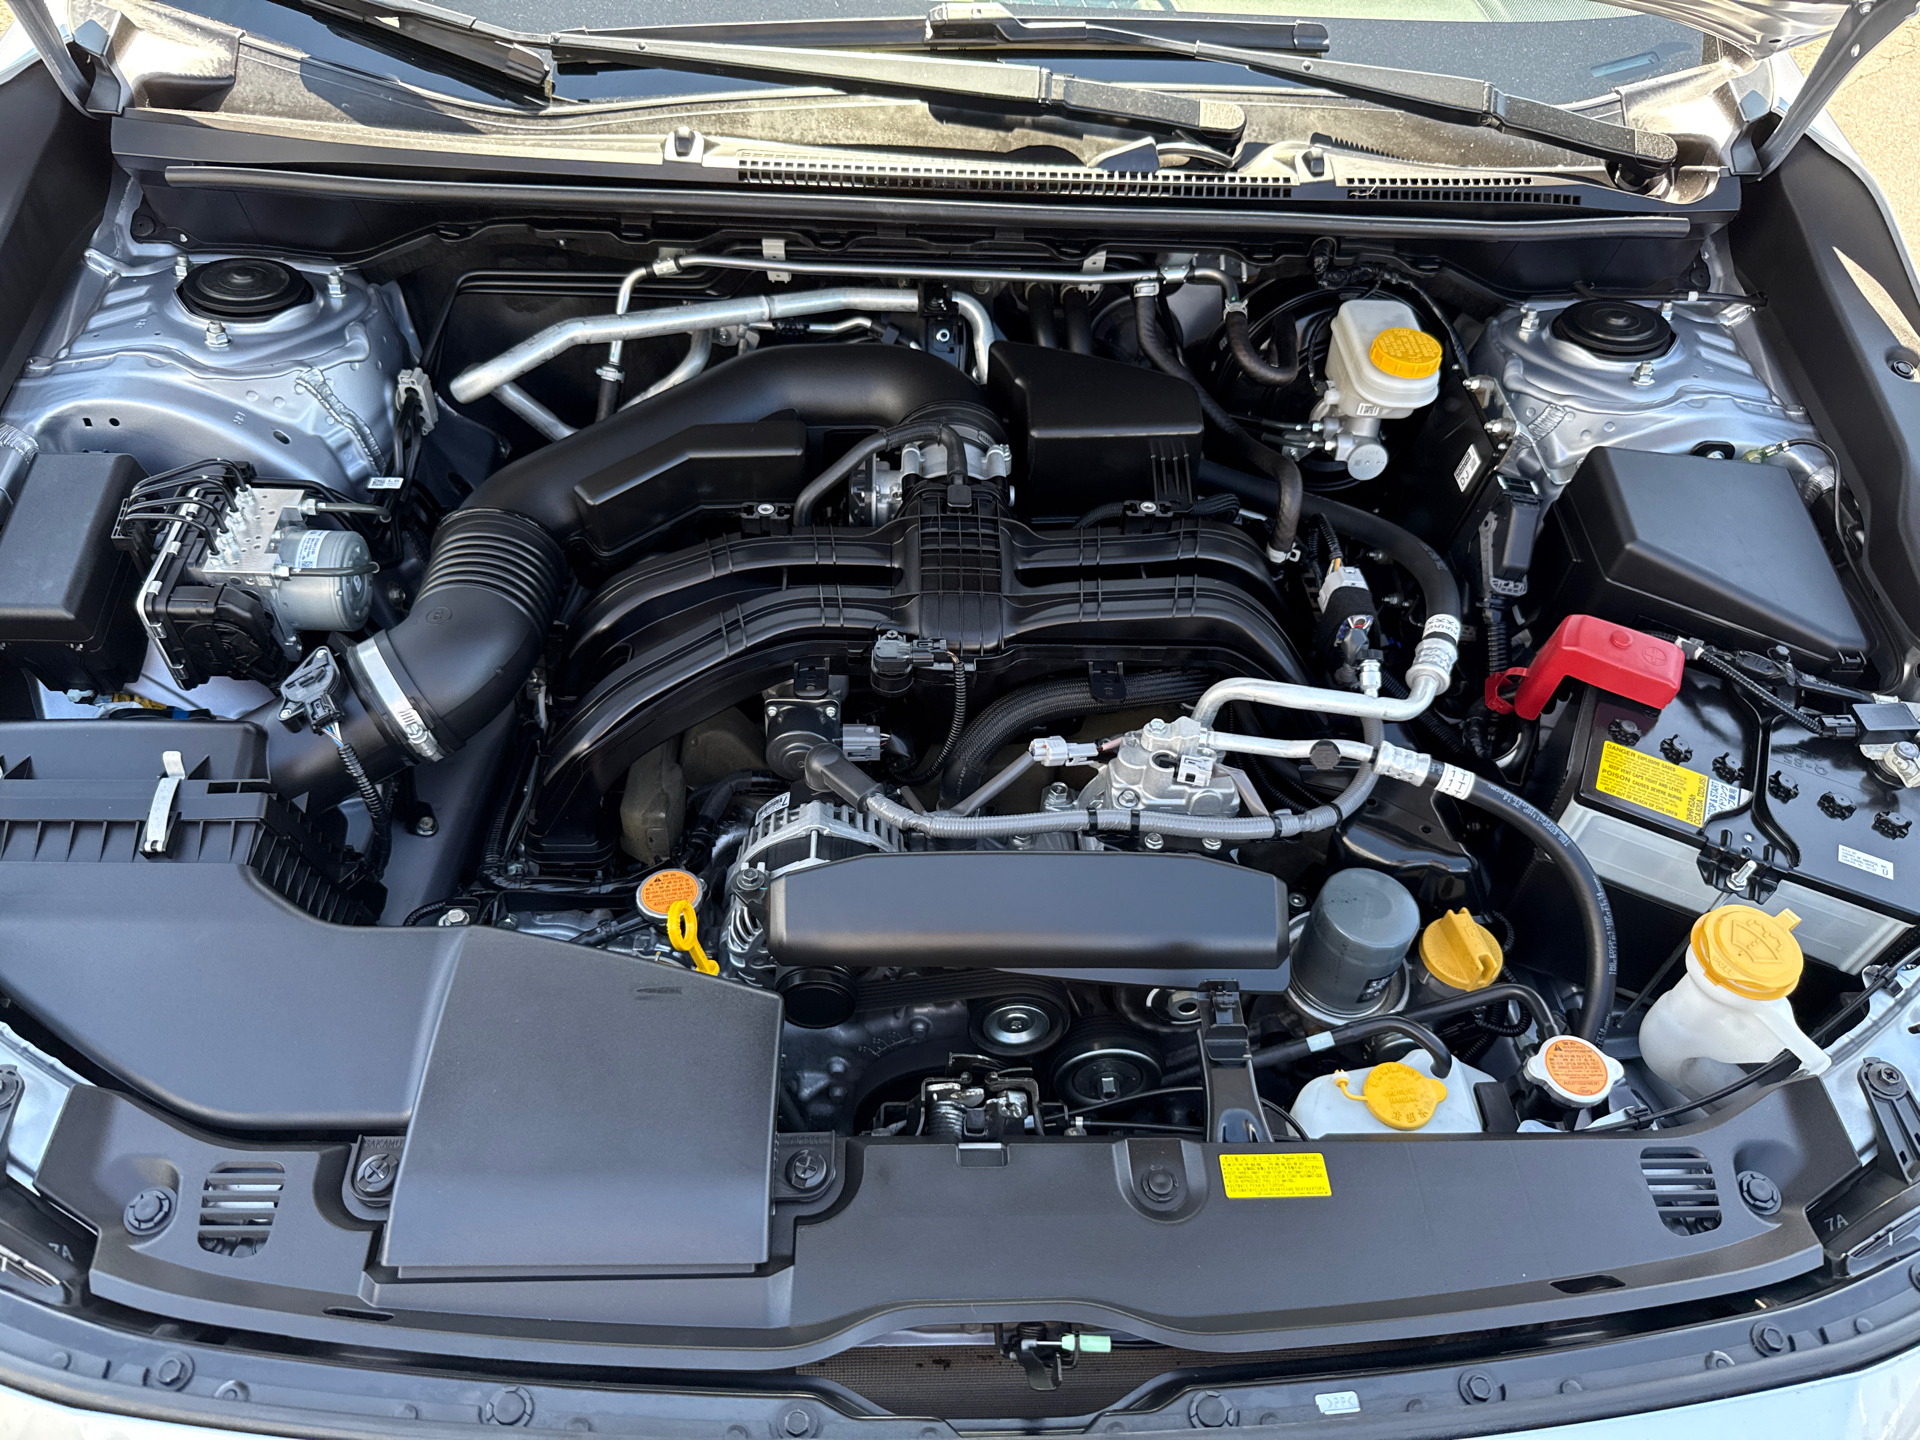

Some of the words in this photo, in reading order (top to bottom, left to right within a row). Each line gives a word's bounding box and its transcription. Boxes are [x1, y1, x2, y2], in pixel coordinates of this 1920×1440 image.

[1606, 744, 1636, 758] DANGER
[1638, 756, 1660, 766] EXPLOSIVE
[1661, 764, 1676, 772] GASES
[1602, 768, 1630, 782] POISON
[1632, 780, 1650, 790] CAUSES
[1650, 786, 1666, 796] SEVERE
[1668, 792, 1682, 802] BURNS
[1645, 778, 1658, 786] TIGHT
[1668, 786, 1682, 794] LEVEL
[1710, 781, 1720, 798] START
[1633, 797, 1648, 806] REACH
[1655, 805, 1678, 816] CHILDREN
[1713, 956, 1736, 977] PULL
[1369, 1064, 1424, 1087] COOLANT
[1824, 1213, 1850, 1232] 7A
